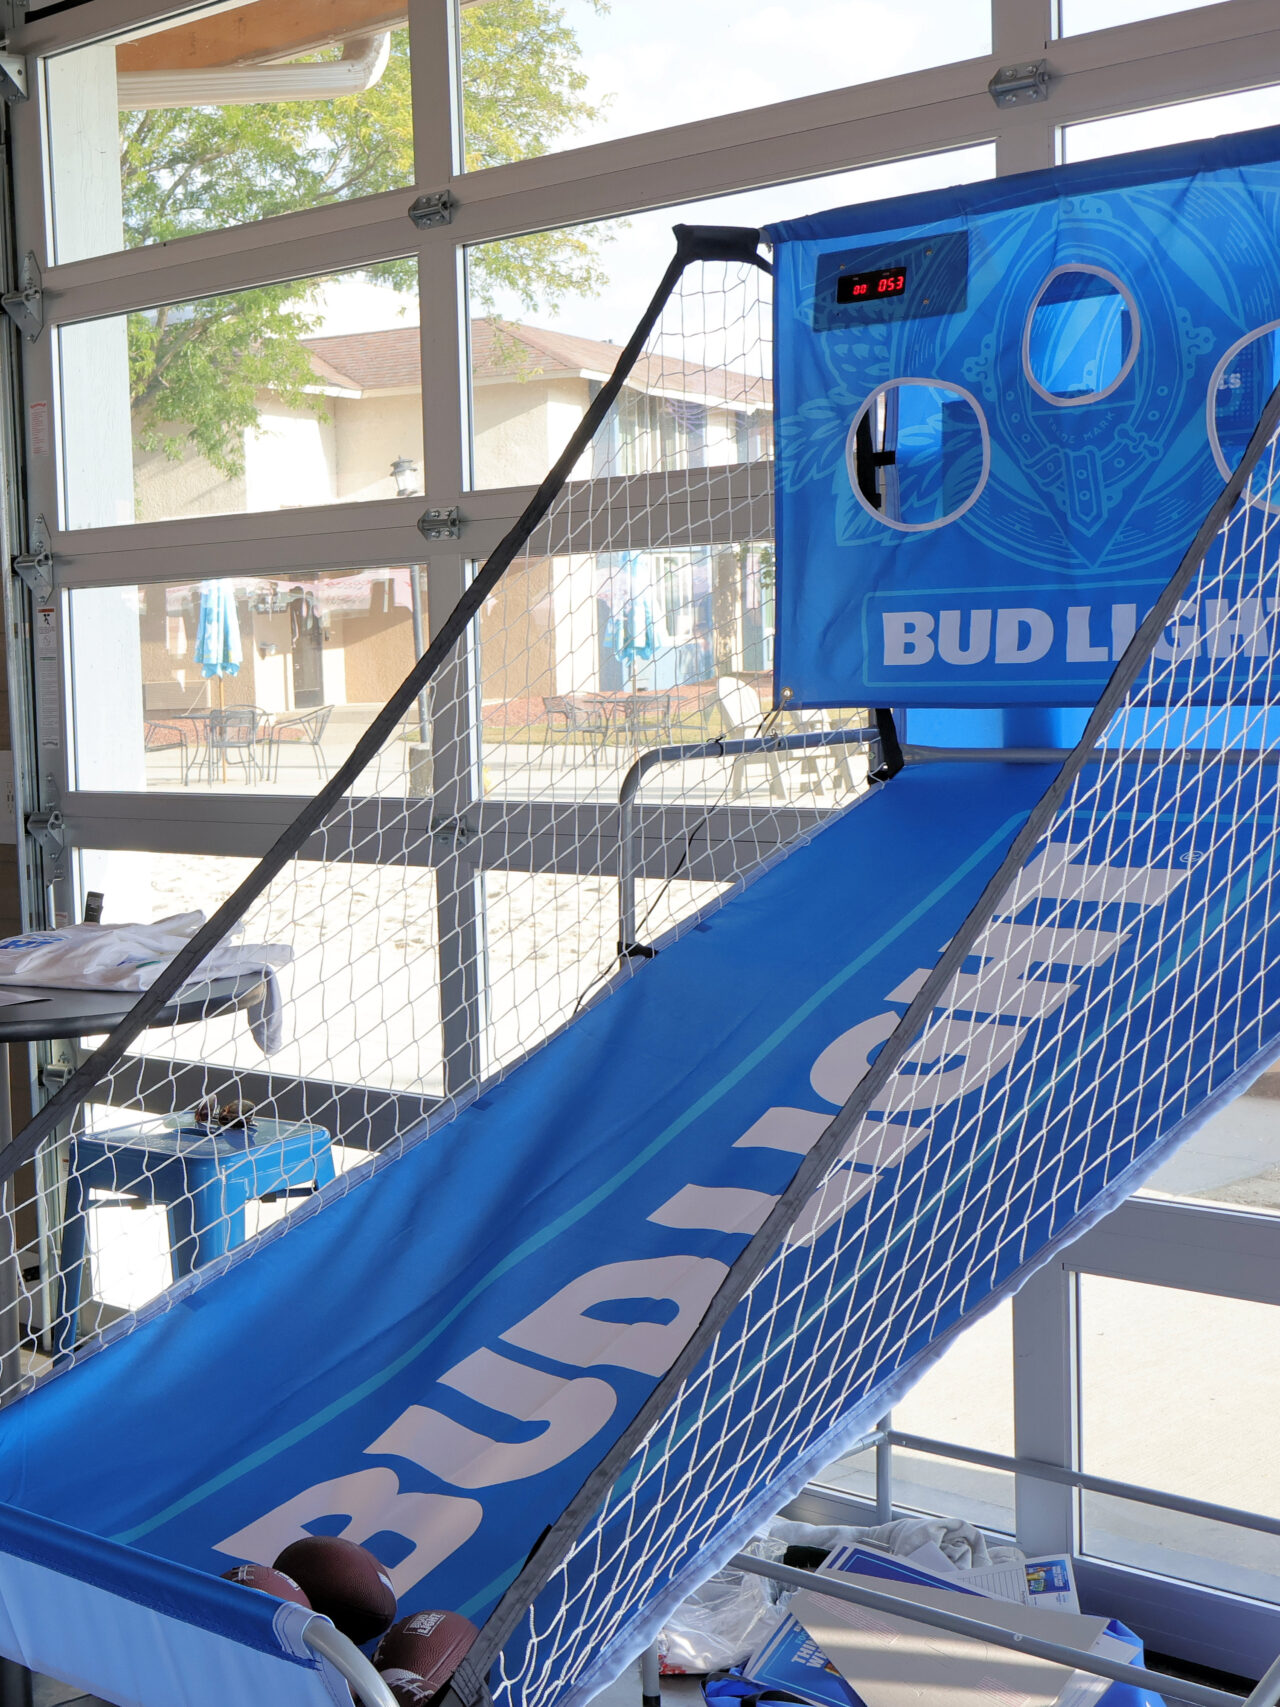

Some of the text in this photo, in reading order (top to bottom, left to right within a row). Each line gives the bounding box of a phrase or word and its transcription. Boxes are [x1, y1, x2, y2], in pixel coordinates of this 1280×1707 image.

[877, 276, 905, 292] 053
[1083, 411, 1116, 441] MARK
[882, 607, 1055, 666] BUD
[212, 1253, 733, 1600] BUD
